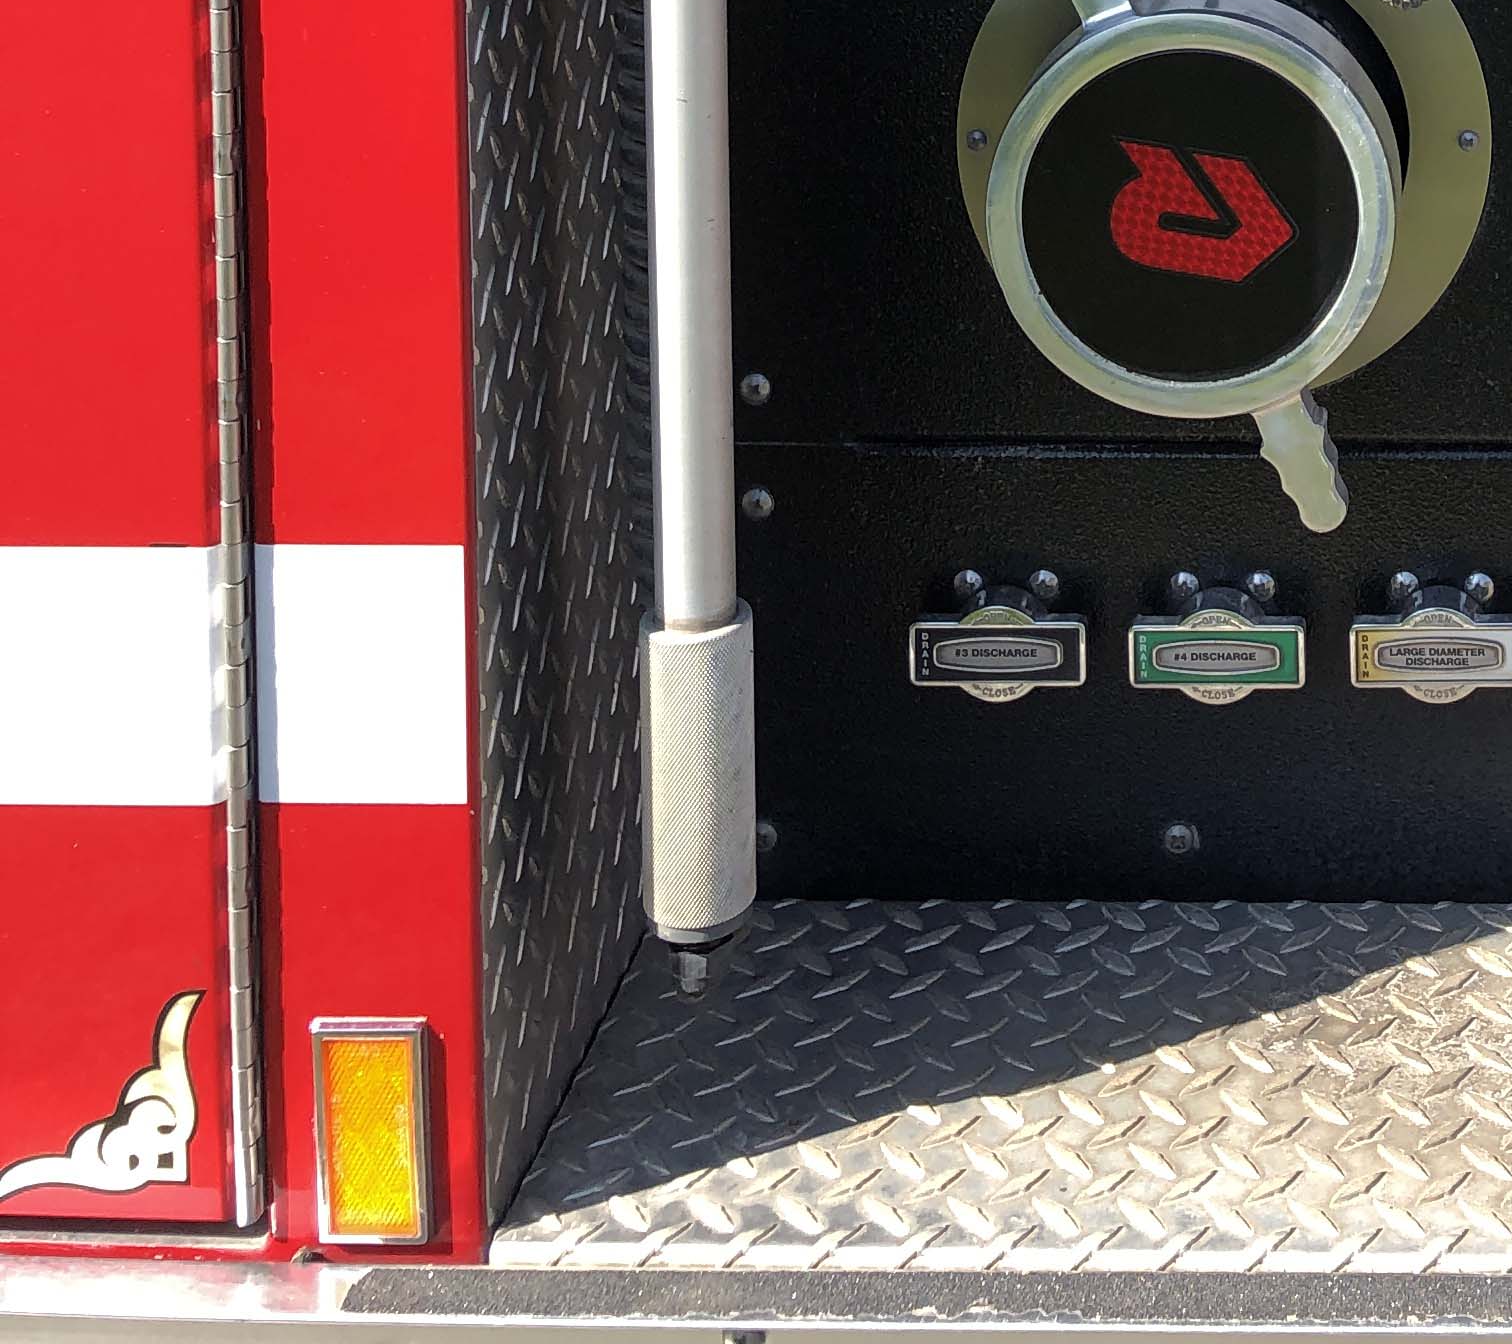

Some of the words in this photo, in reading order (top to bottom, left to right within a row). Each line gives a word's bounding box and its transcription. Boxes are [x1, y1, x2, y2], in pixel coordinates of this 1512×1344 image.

[1201, 615, 1231, 625] OPEN
[921, 632, 930, 676] DRAIN
[955, 648, 969, 658] #3
[971, 648, 1038, 658] DISCHARGE
[1139, 635, 1148, 679] DRAIN
[1174, 653, 1188, 661] #4
[1190, 652, 1257, 661] DISCHARGE
[1361, 635, 1370, 678] DRAIN
[1389, 648, 1426, 657] LARGE
[1428, 648, 1486, 657] DIAMETER
[1405, 657, 1470, 666] DISCHARGE
[982, 686, 1017, 698] CLOSE
[1201, 688, 1236, 700] CLOSE
[1423, 688, 1458, 699] CLOSE
